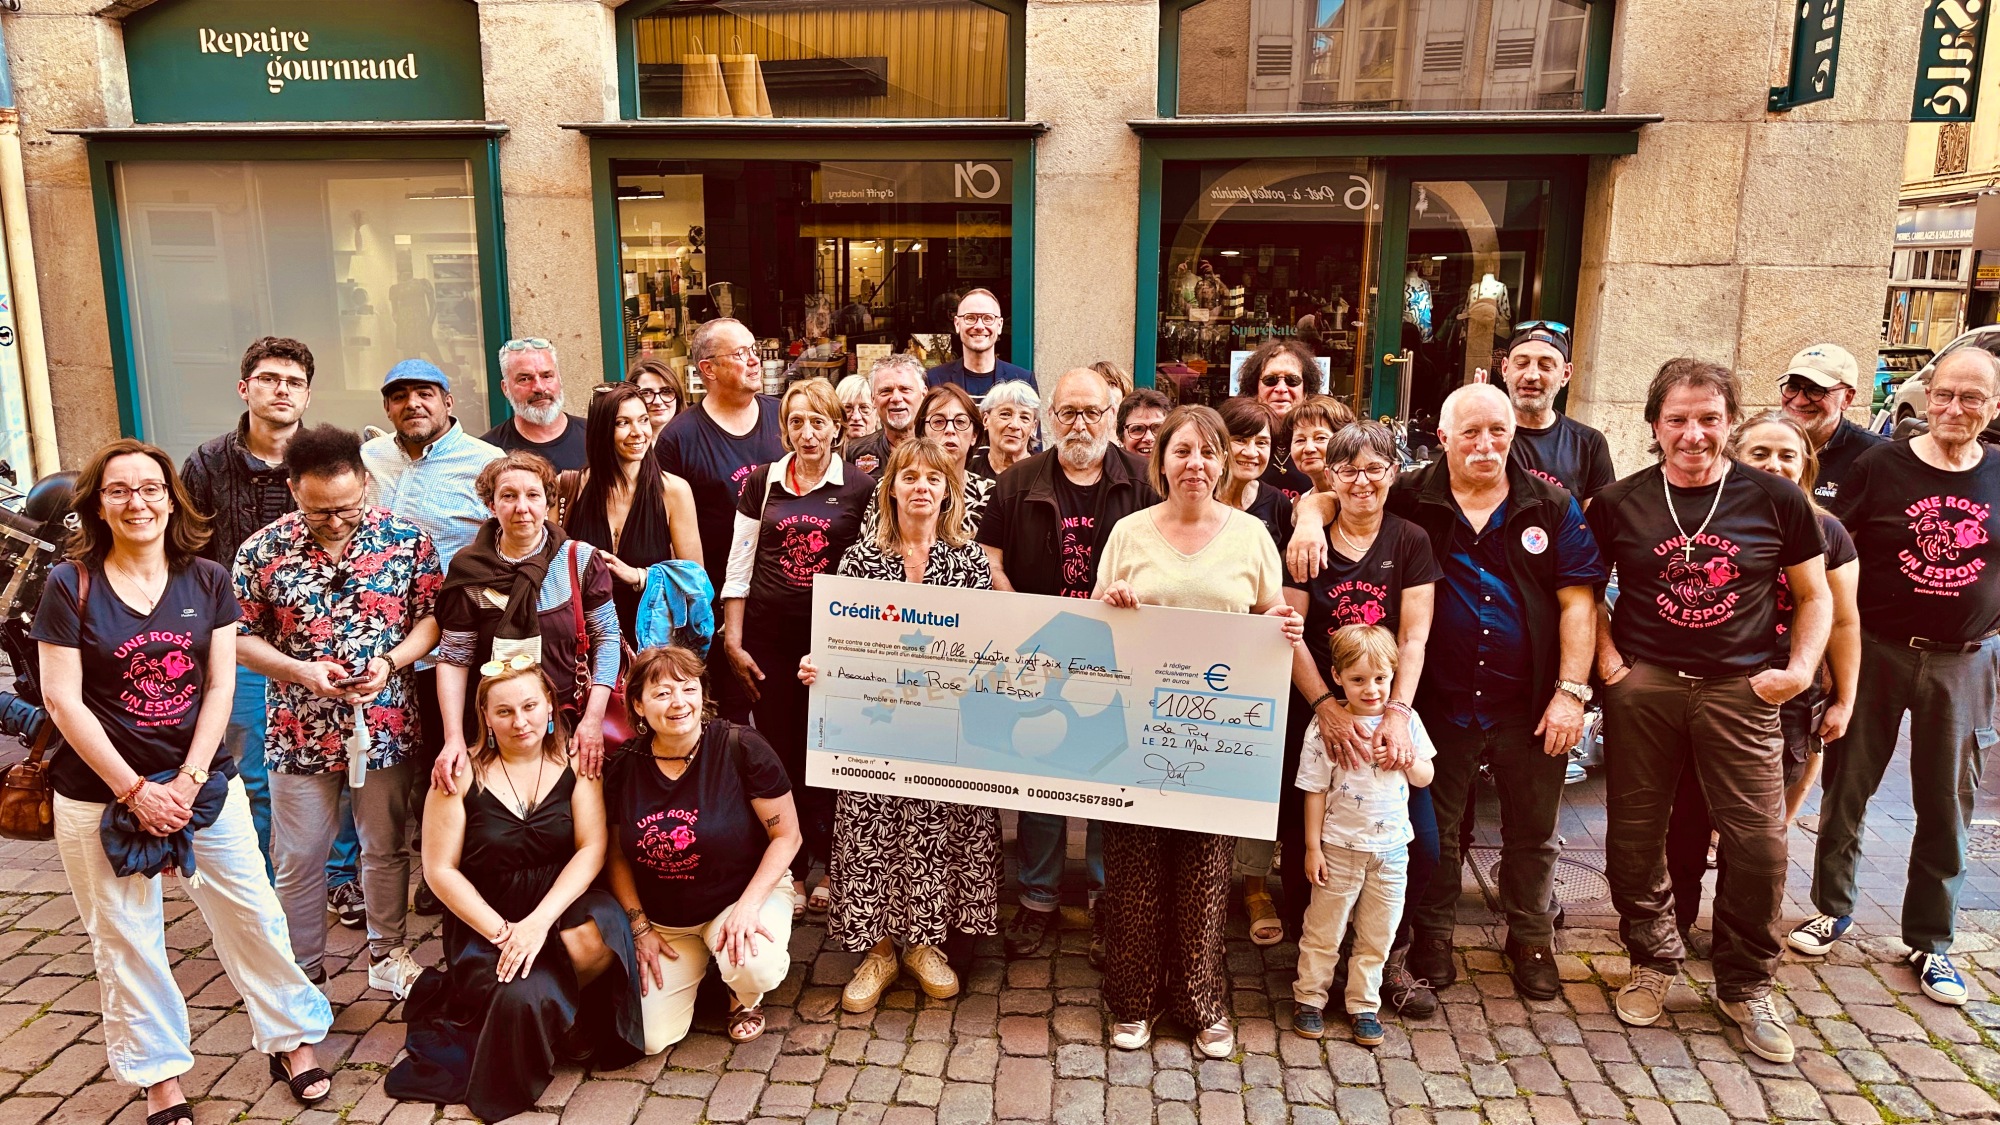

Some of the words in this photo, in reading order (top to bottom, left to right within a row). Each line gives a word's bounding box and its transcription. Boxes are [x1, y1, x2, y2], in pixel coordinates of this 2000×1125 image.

[199, 27, 309, 57] Repaire
[266, 53, 418, 94] gourmand
[731, 466, 750, 482] UNE
[1282, 489, 1299, 498] RO
[1905, 496, 1942, 517] UNE
[1945, 496, 1989, 521] ROSE
[775, 515, 799, 531] UNE
[801, 514, 831, 531] ROSE
[1653, 535, 1688, 556] UNE
[1695, 534, 1741, 557] ROSE
[779, 555, 793, 570] UN
[793, 557, 830, 575] ESPOIR
[1898, 549, 1922, 570] UN
[1923, 558, 1986, 580] ESPOIR
[1900, 565, 1909, 574] Le
[1908, 572, 1928, 584] cœur
[1929, 580, 1943, 588] des
[1945, 574, 1978, 588] motards
[1328, 581, 1353, 598] UNE
[1356, 581, 1387, 601] ROSE
[829, 601, 880, 620] Crédit
[901, 608, 960, 628] Mutuel
[1656, 593, 1679, 615] UN
[1681, 592, 1740, 621] ESPOIR
[1658, 609, 1667, 618] Le
[1666, 616, 1687, 627] cœur
[1705, 610, 1734, 628] motards
[114, 634, 148, 659] UNE
[149, 631, 193, 650] ROSE
[828, 636, 844, 644] Payez
[872, 642, 892, 650] chèque
[838, 645, 866, 653] endossable
[931, 640, 966, 660] Mille
[974, 649, 1009, 664] quatre
[1015, 653, 1039, 671] vingt
[1041, 659, 1062, 669] six
[1155, 669, 1199, 678] exclusivement
[1169, 662, 1191, 670] rédiger
[837, 666, 887, 683] Association
[896, 668, 918, 687] Une
[924, 670, 962, 691] Rose
[975, 679, 989, 693] Un
[996, 680, 1041, 700] Espoir
[1203, 663, 1231, 691] €
[120, 690, 142, 708] UN
[144, 683, 197, 712] ESPOIR
[863, 694, 888, 703] Payable
[899, 698, 921, 707] France
[167, 700, 192, 716] motards
[1243, 702, 1263, 727] €
[160, 718, 180, 726] VELAY
[1181, 723, 1209, 741] Puy
[1142, 737, 1154, 745] LE
[1161, 737, 1177, 748] 22
[1185, 738, 1209, 755] Mai
[1215, 740, 1254, 756] 2026
[847, 756, 868, 764] Chèque
[636, 811, 664, 828] UNE
[667, 809, 698, 826] ROSE
[661, 853, 701, 868] ESPOIR
